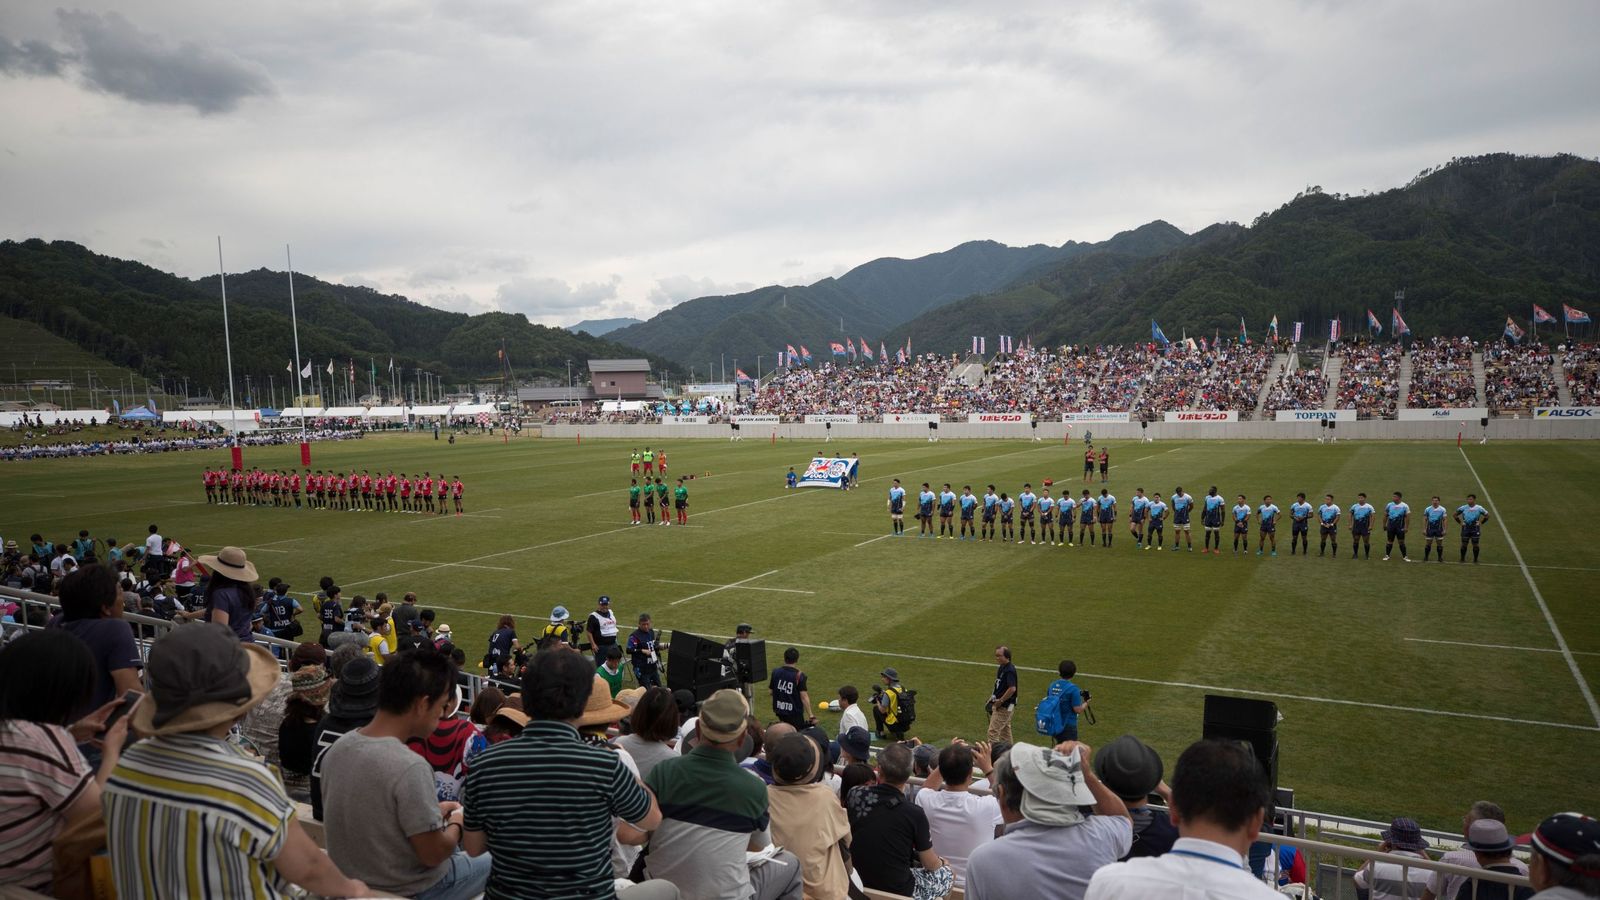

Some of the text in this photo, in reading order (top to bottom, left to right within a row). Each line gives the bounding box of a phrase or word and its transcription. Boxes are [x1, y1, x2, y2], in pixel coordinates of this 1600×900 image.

[1294, 412, 1337, 420] TOPPAN
[1548, 408, 1592, 417] ALSOK
[777, 679, 794, 695] 449
